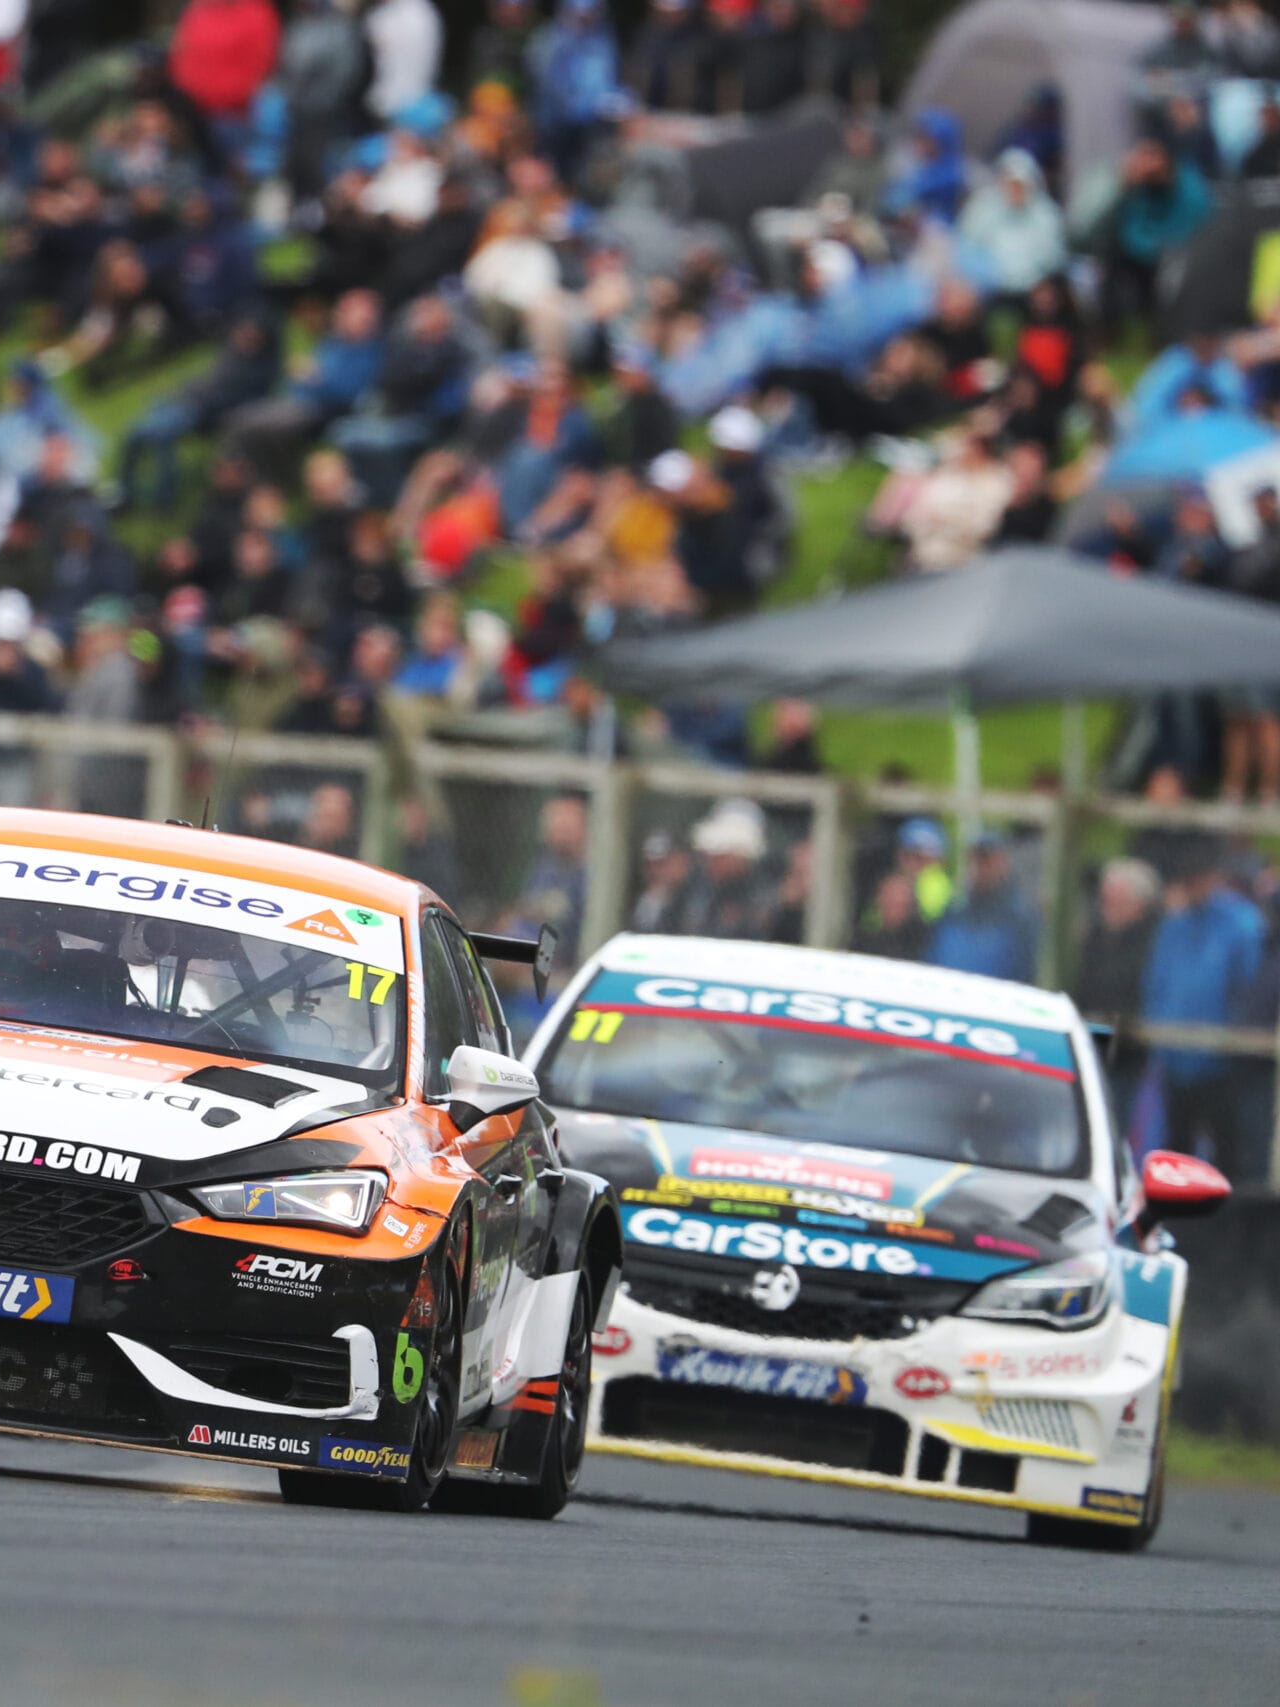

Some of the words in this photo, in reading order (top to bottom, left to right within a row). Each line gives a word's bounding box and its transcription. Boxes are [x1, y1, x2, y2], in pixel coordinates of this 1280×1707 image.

[304, 919, 345, 938] Re.
[345, 962, 396, 1006] 17
[570, 1009, 624, 1044] 11
[634, 978, 1018, 1056] CarStore
[627, 1208, 917, 1274] CarStore
[231, 1272, 261, 1282] VEHICLE
[264, 1277, 322, 1292] ENHANCEMENTS
[237, 1281, 254, 1289] AND
[257, 1284, 315, 1298] MODIFICATIONS
[214, 1430, 276, 1450] MILLERS
[279, 1438, 311, 1455] OILS
